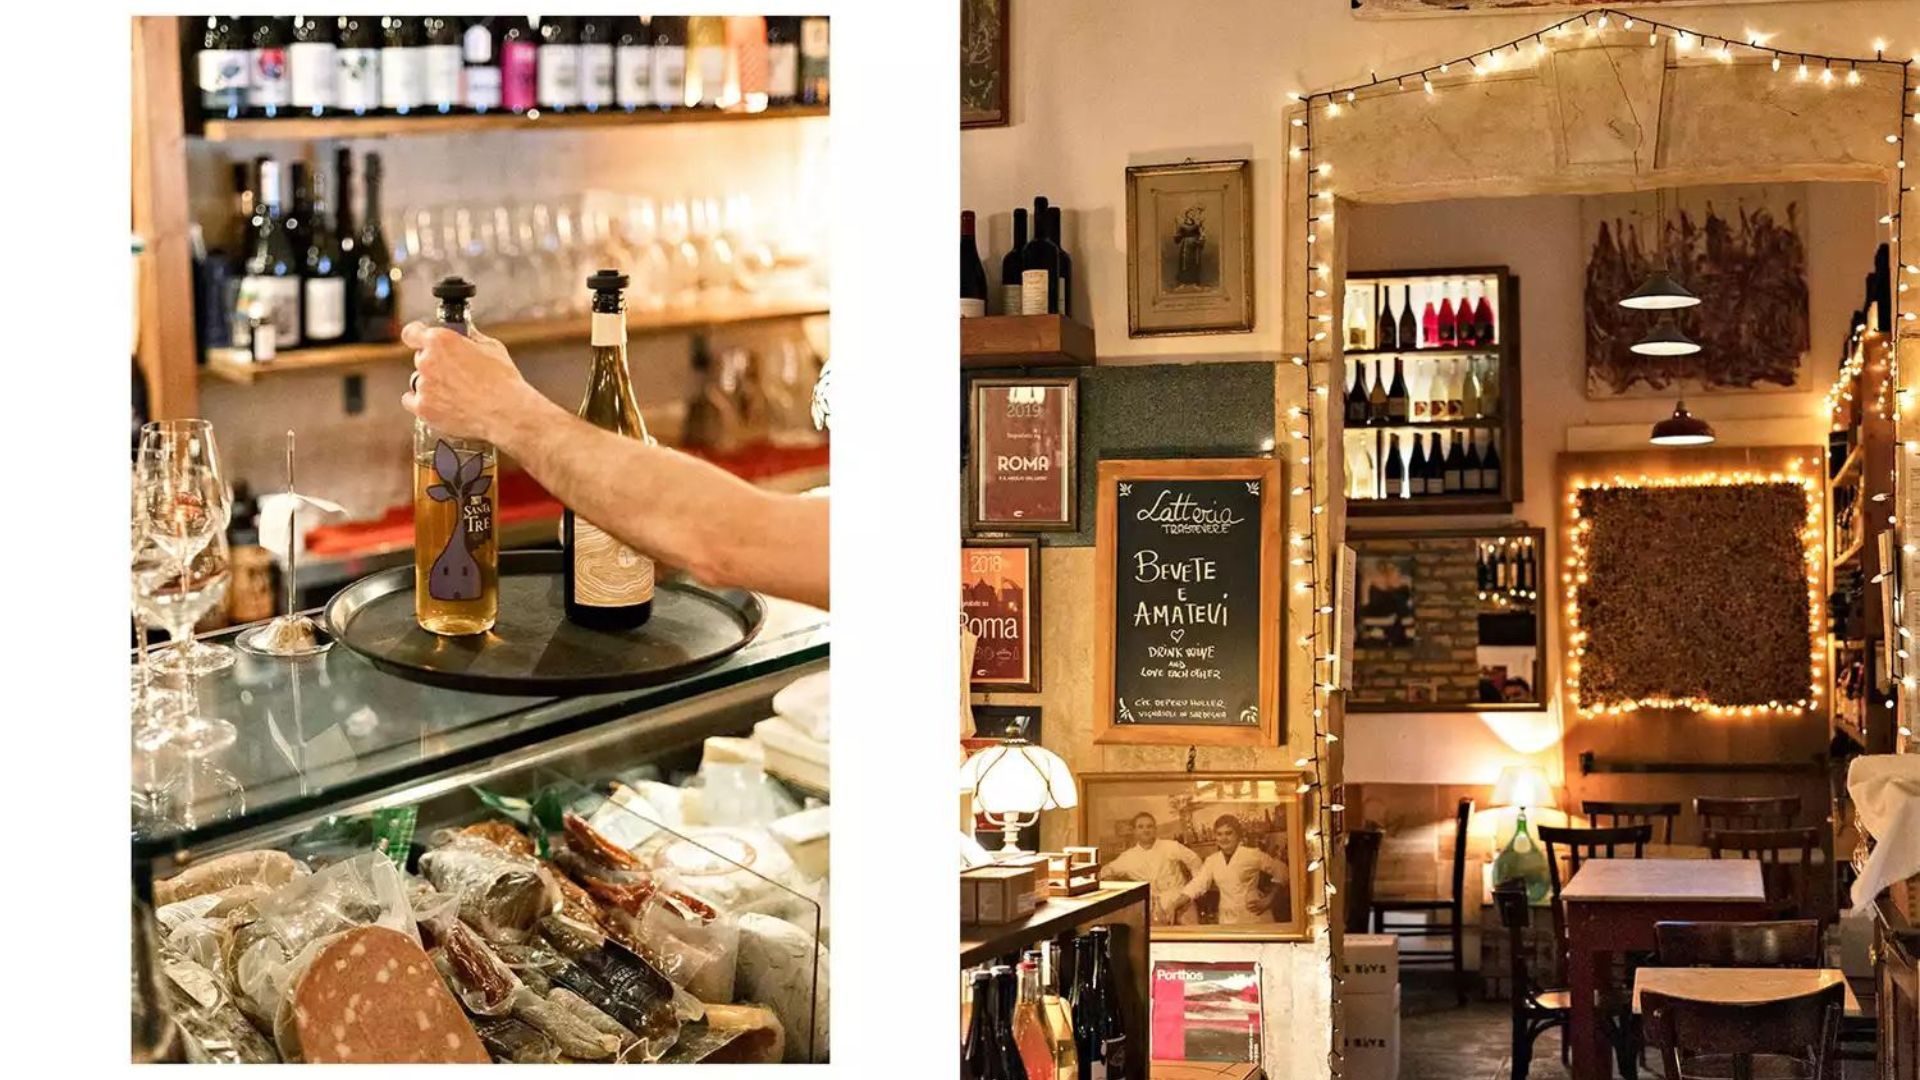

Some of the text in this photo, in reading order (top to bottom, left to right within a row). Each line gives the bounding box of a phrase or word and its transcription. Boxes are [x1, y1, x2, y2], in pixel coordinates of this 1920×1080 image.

[1006, 403, 1040, 418] 2019
[997, 455, 1049, 471] ROMA
[1136, 489, 1245, 525] Latteria
[1161, 524, 1231, 535] TRASTEVERE
[970, 554, 1003, 574] 2018
[1133, 549, 1216, 583] BEVETE
[1177, 587, 1187, 602] E
[1133, 593, 1229, 627] AMATEVI
[1147, 643, 1215, 660] DRINK WINE
[1168, 661, 1186, 669] AND
[1140, 667, 1222, 680] LOVE EACH OTHER
[1156, 968, 1205, 981] Porthos
